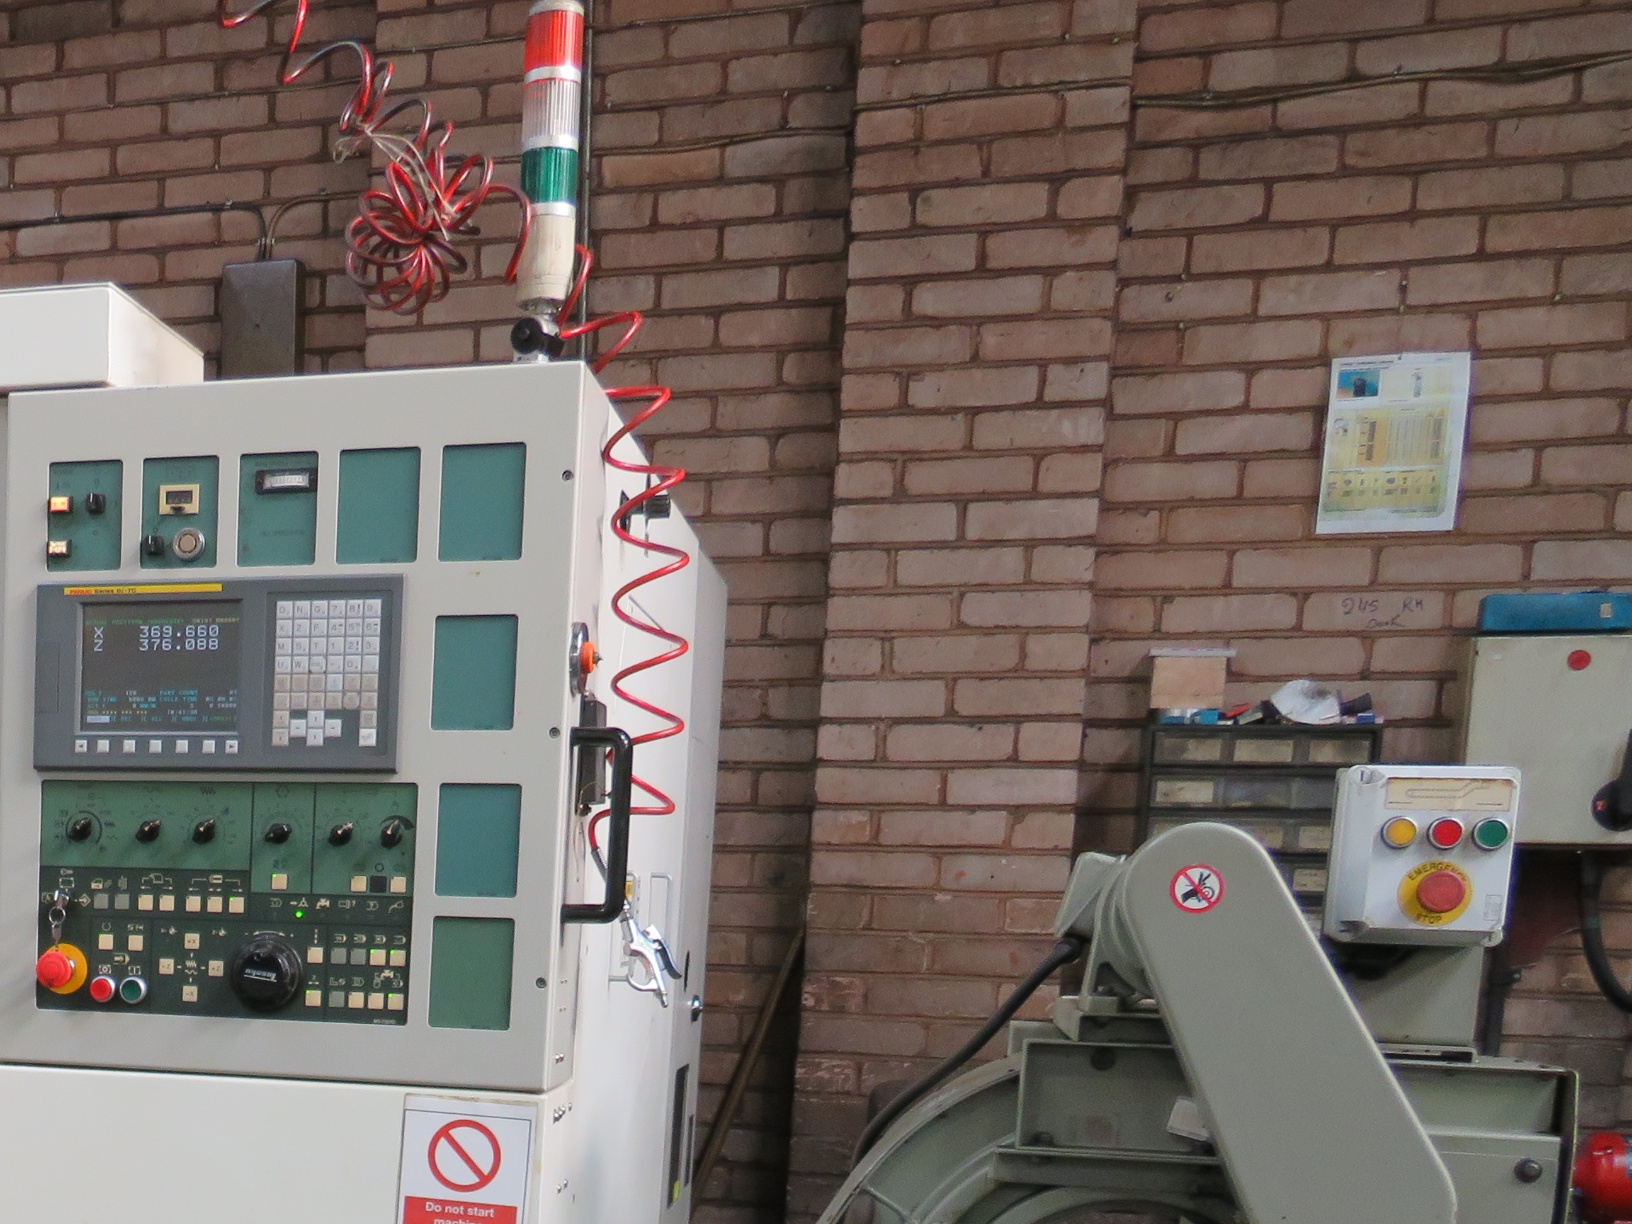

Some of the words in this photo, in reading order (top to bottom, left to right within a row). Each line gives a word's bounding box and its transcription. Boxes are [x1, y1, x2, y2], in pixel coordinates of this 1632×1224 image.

[94, 627, 104, 638] X
[139, 625, 219, 638] 369.660
[94, 640, 104, 652] Z
[139, 638, 219, 651] 376.088
[425, 1201, 442, 1213] Do
[445, 1204, 464, 1216] not
[467, 1206, 494, 1218] start
